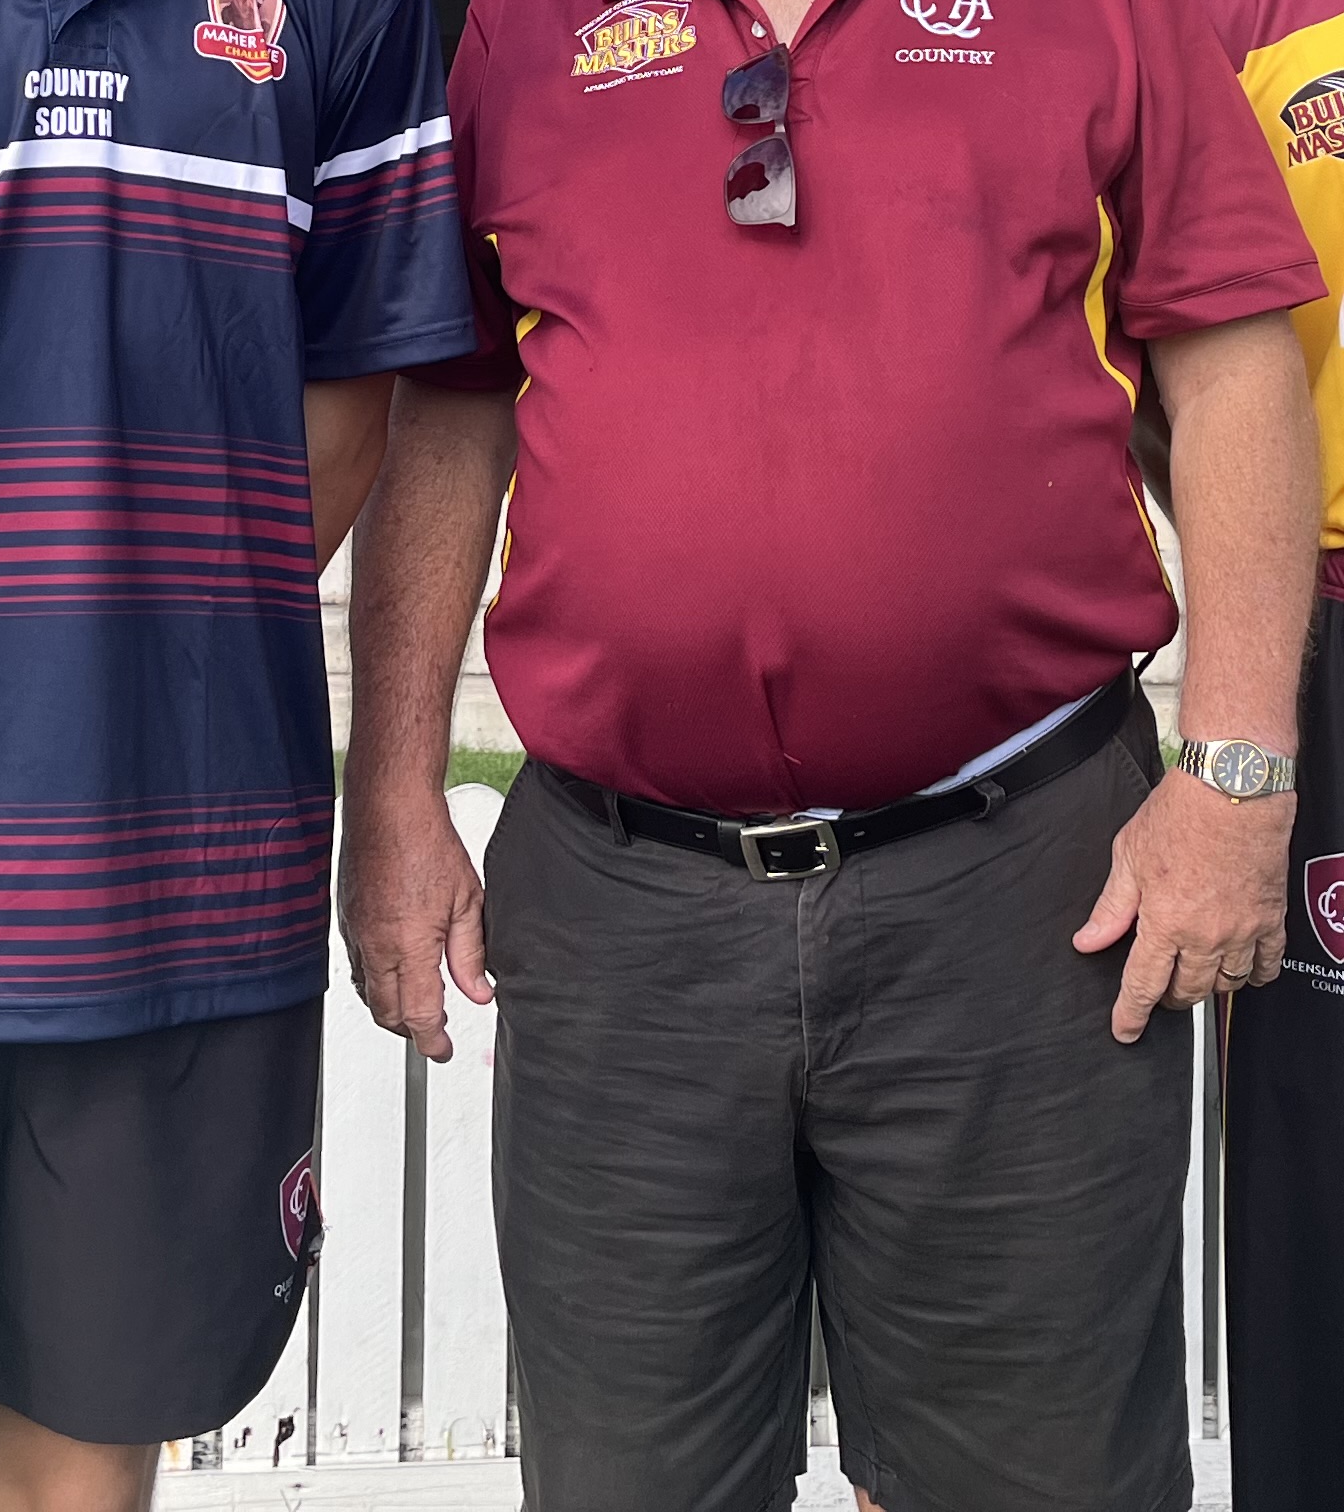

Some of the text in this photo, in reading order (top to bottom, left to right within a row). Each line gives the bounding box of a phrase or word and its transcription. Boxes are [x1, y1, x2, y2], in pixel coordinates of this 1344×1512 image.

[202, 27, 257, 48] MAHER
[594, 9, 679, 50] BULLS
[571, 26, 696, 76] MASTERS
[895, 48, 995, 65] COUNTRY
[24, 68, 129, 102] COUNTRY
[35, 106, 112, 137] SOUTH
